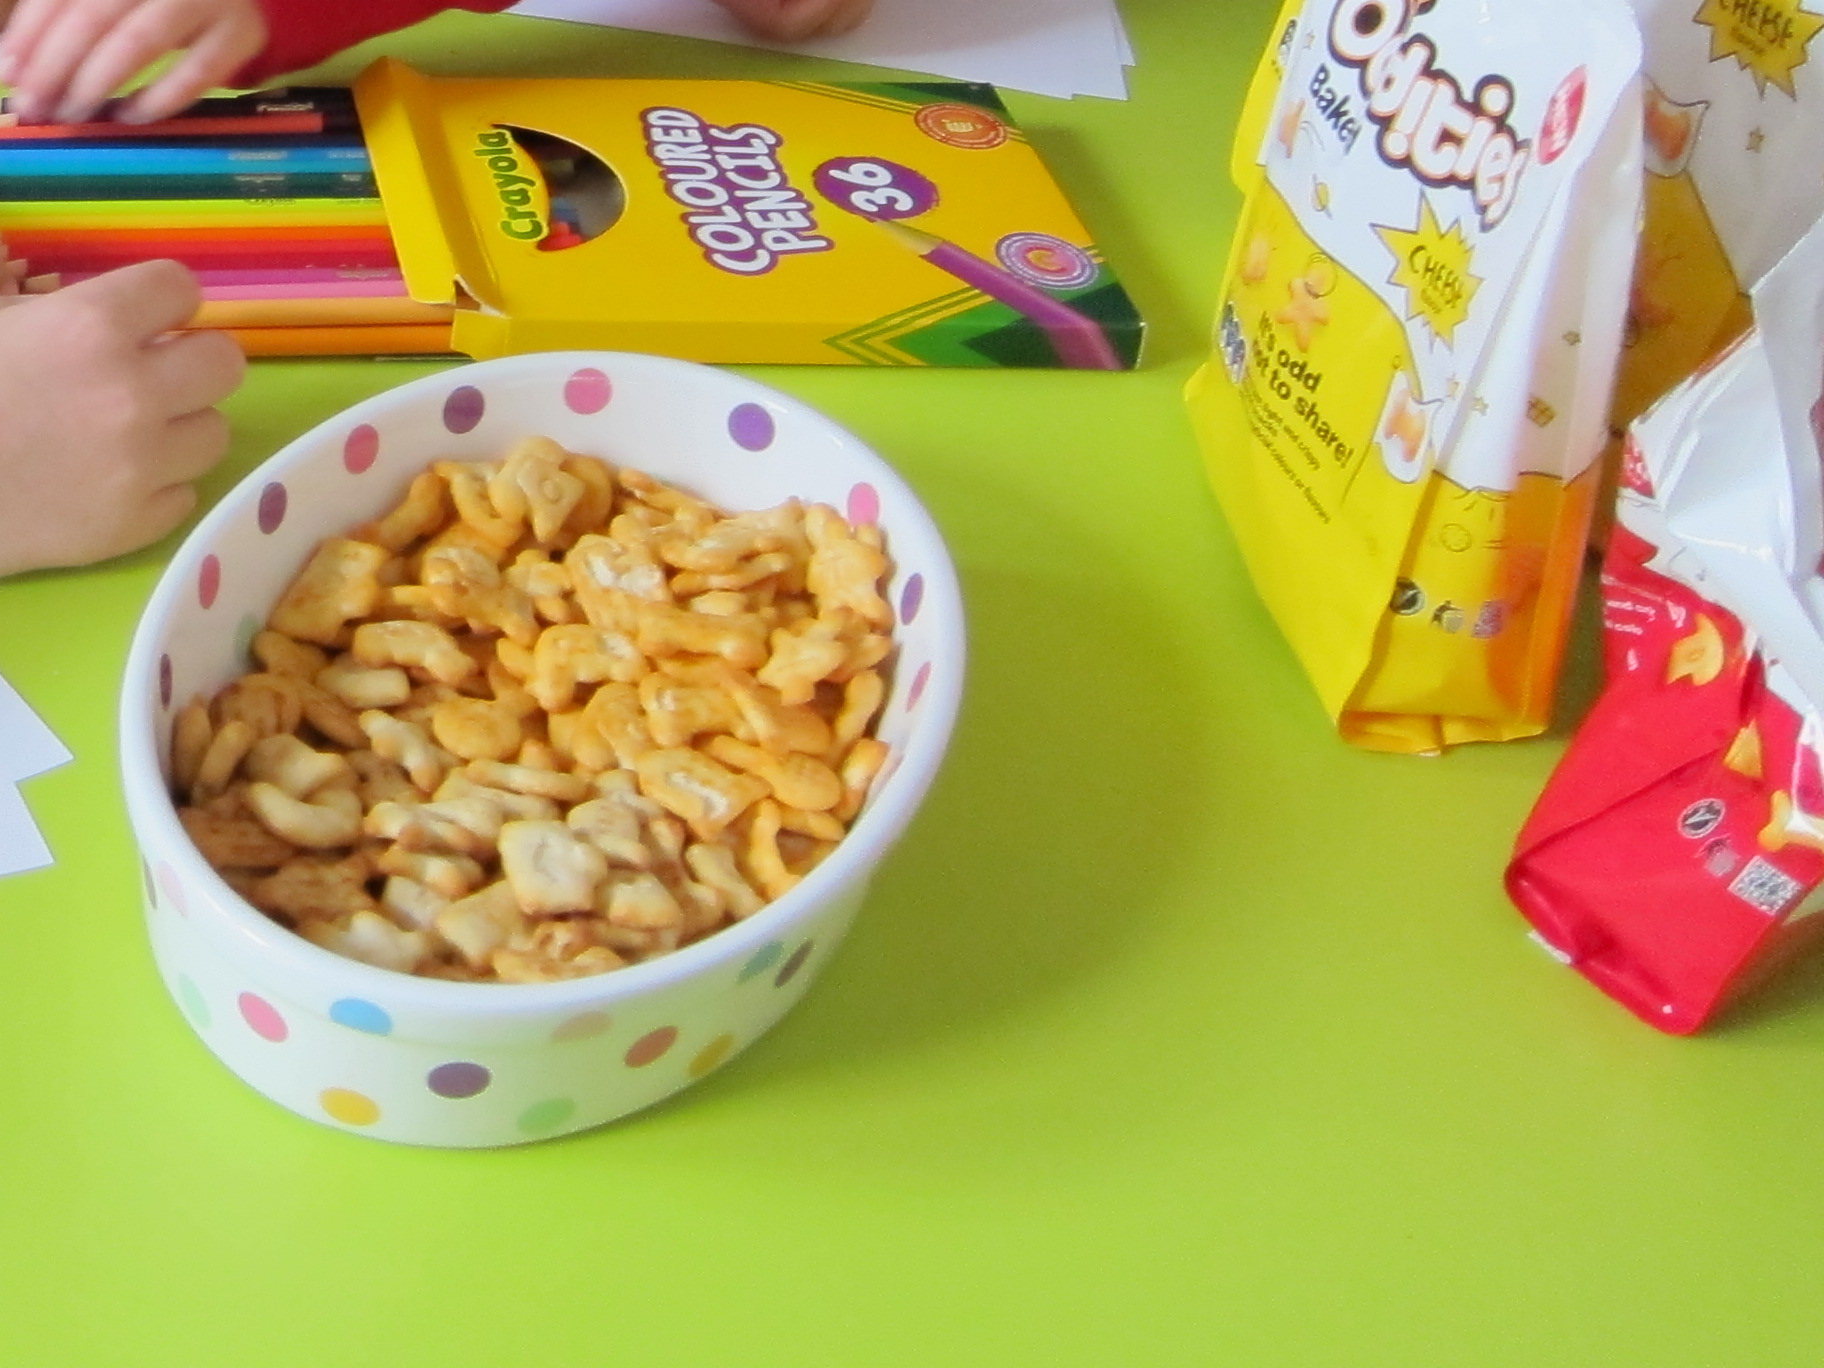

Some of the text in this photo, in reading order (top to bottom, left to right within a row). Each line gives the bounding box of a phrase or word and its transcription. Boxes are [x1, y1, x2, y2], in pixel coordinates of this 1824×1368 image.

[475, 130, 547, 241] Crayola
[645, 108, 772, 273] COLOURED
[711, 126, 829, 253] PENCILS
[828, 161, 915, 213] 36
[1269, 368, 1292, 401] to
[1294, 396, 1355, 469] share!
[1277, 349, 1323, 394] odd
